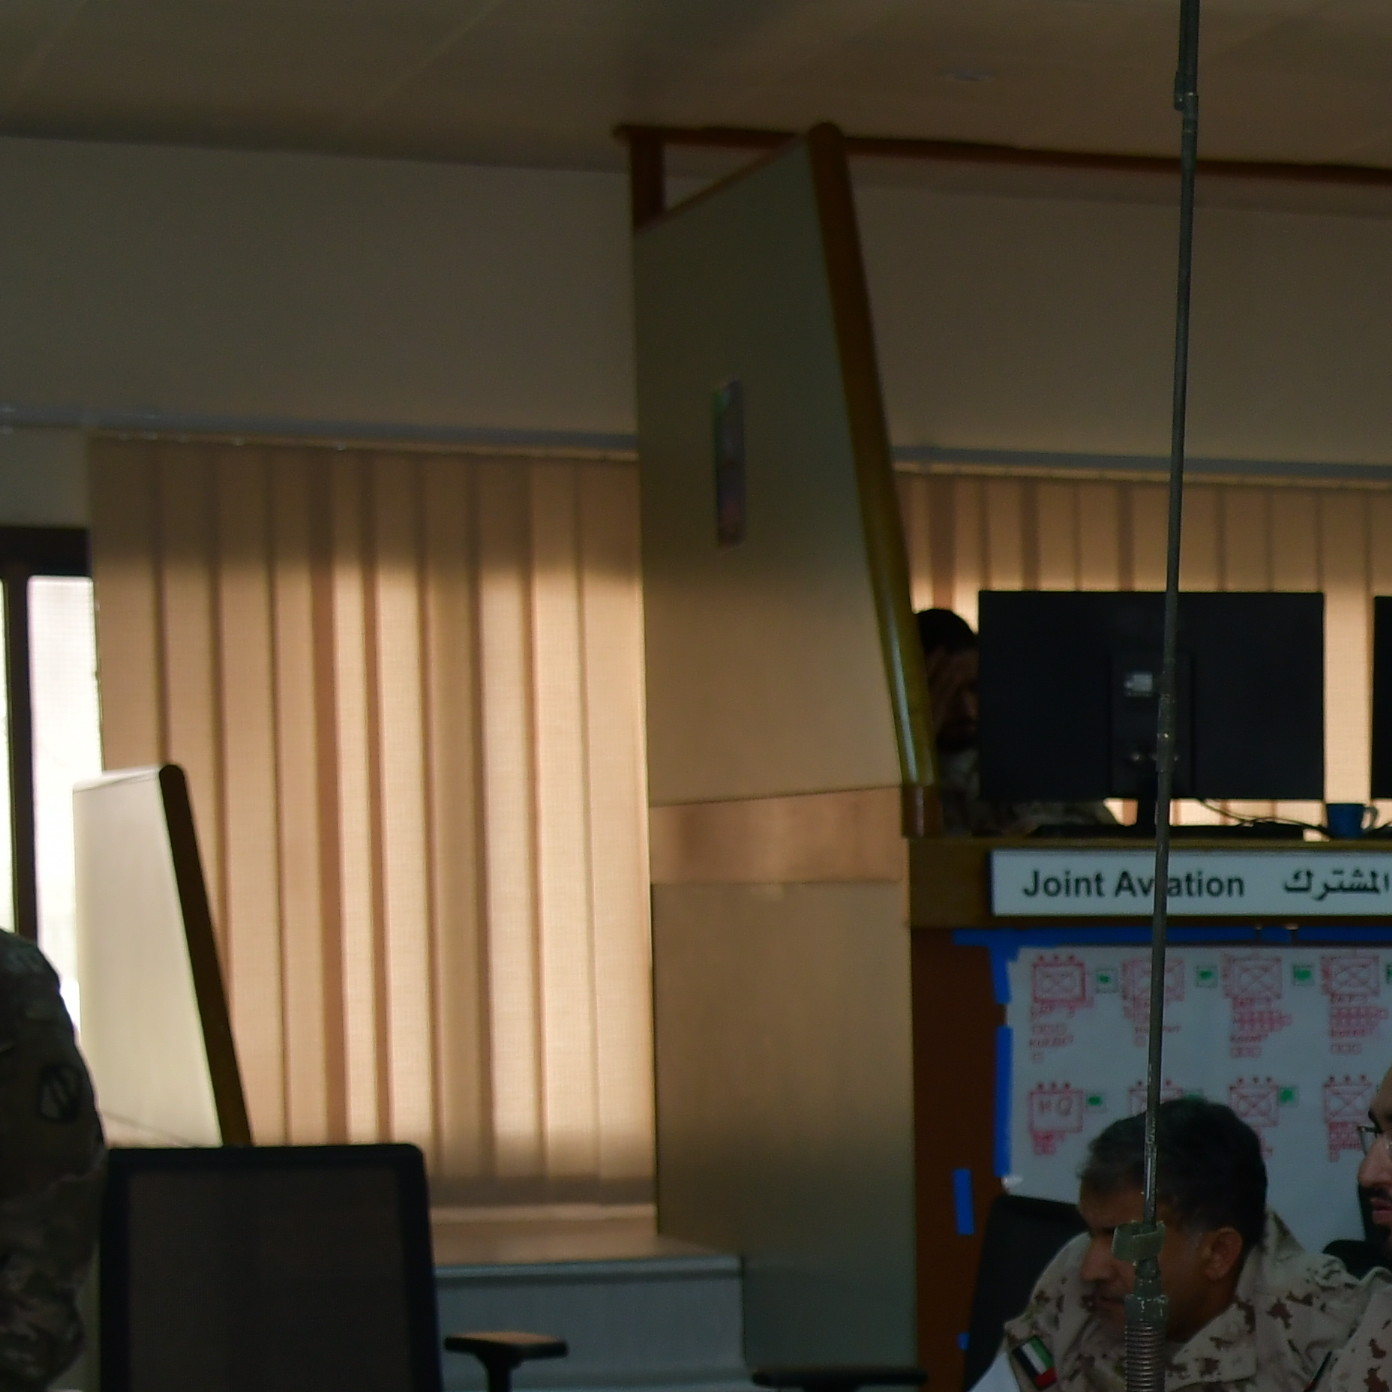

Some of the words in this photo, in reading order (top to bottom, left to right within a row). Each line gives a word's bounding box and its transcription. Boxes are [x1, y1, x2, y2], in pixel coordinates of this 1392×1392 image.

[1024, 870, 1105, 898] Joint
[1115, 870, 1245, 898] Avation
[1283, 868, 1390, 902] المشترك
